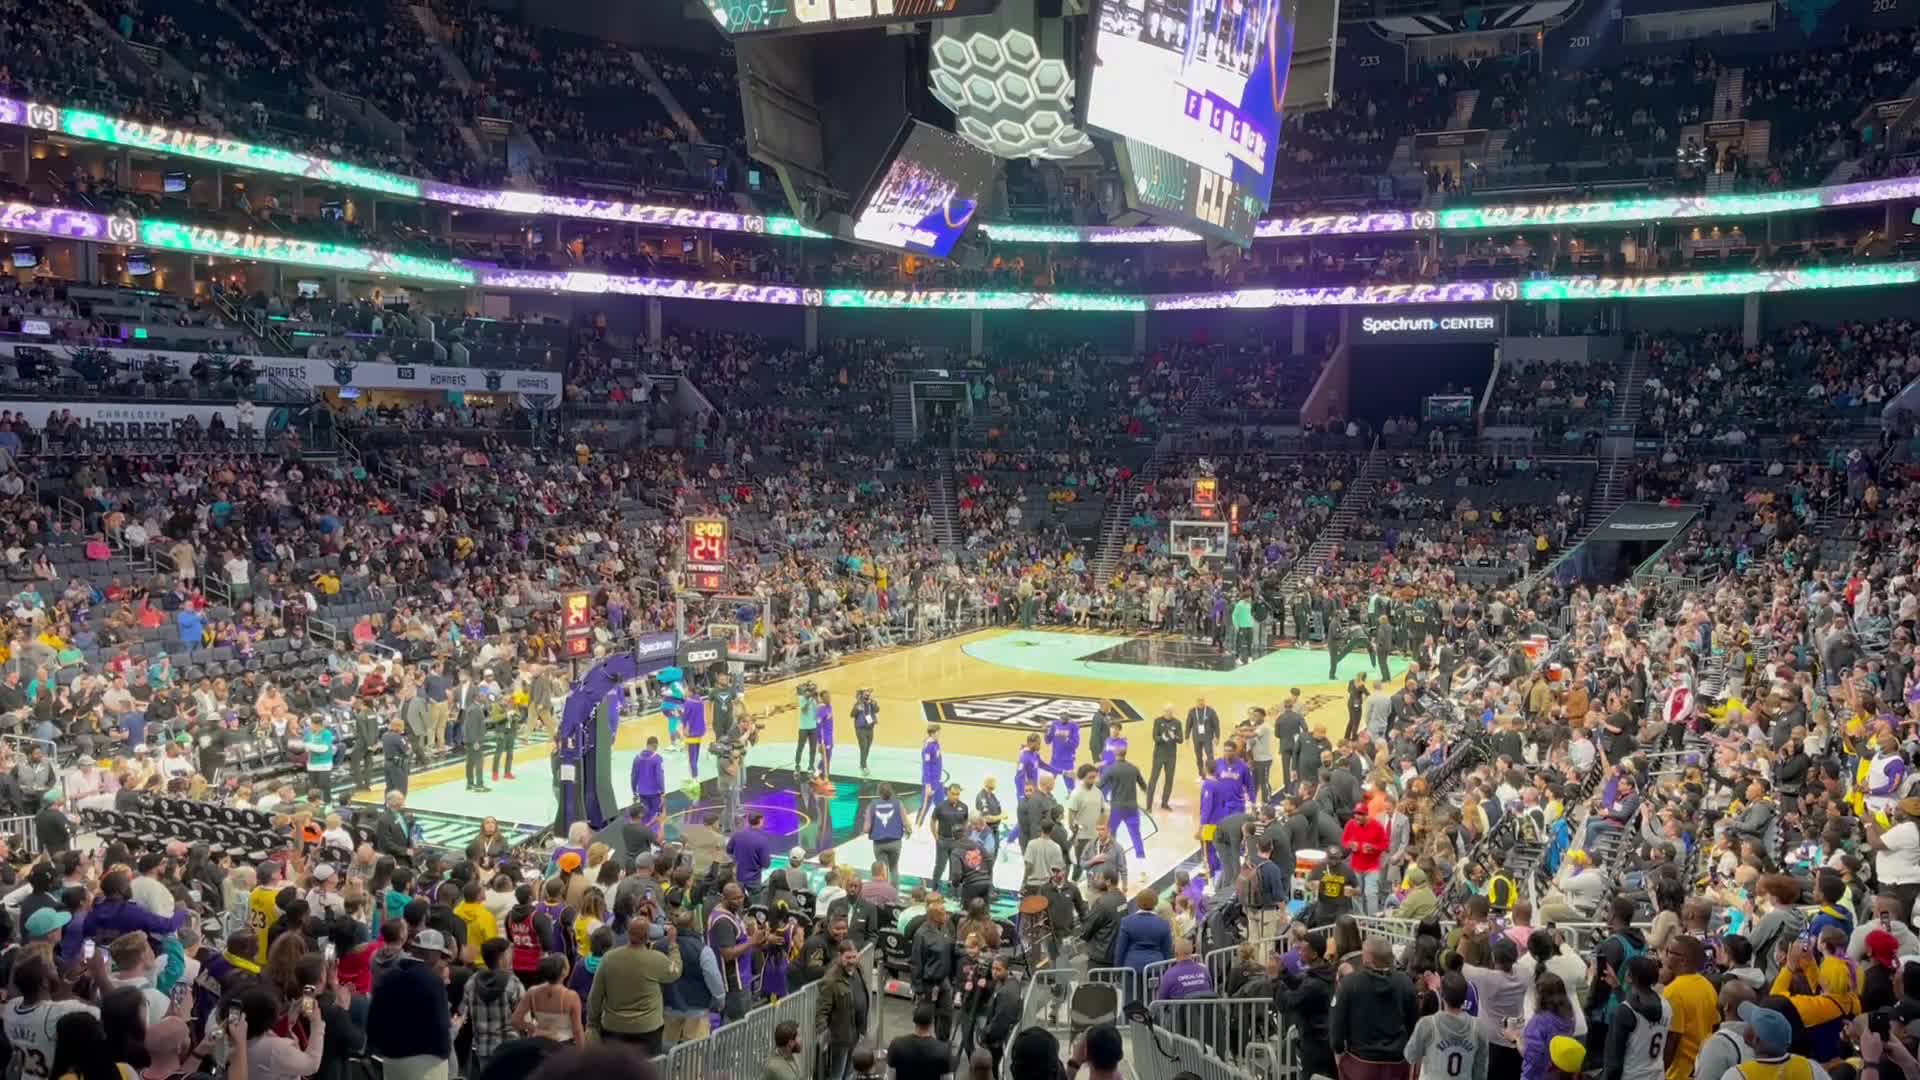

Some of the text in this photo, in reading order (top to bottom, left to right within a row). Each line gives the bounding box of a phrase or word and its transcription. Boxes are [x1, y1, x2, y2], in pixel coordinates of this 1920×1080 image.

[1569, 37, 1591, 49] 201
[1359, 55, 1381, 67] 233
[33, 107, 54, 126] VS
[1196, 168, 1232, 228] CLT
[746, 217, 761, 230] VS
[1415, 213, 1432, 226] VS
[112, 222, 132, 239] VS
[806, 291, 820, 304] VS
[1496, 285, 1514, 299] VS
[1362, 317, 1494, 334] Spectrum CENTER
[694, 537, 720, 560] 24
[640, 640, 673, 656] Spectrum
[251, 908, 266, 929] 23
[1649, 1032, 1663, 1059] 6
[1447, 1052, 1462, 1077] 0
